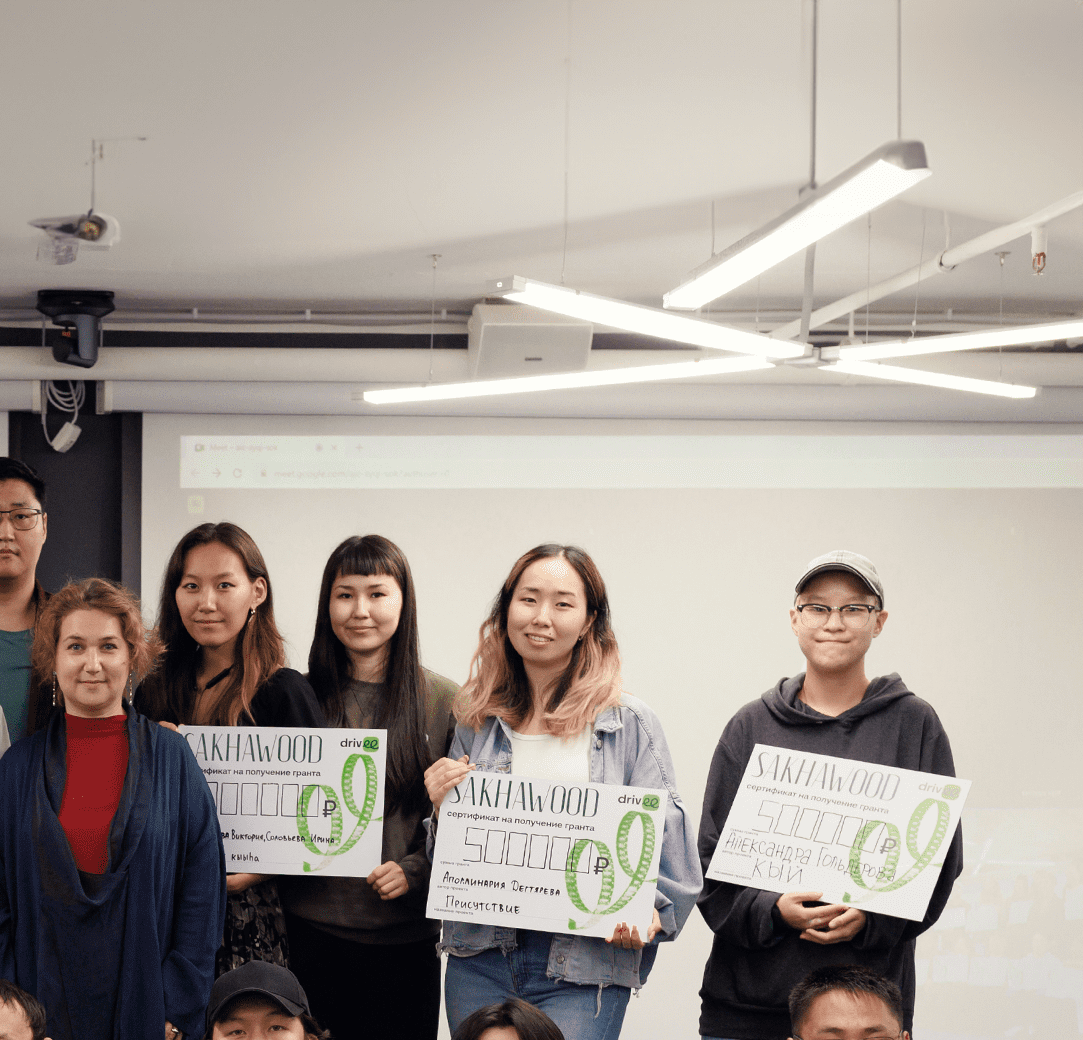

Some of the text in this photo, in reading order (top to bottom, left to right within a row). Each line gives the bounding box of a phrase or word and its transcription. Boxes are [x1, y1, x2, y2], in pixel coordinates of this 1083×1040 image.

[340, 738, 379, 750] drivee
[245, 769, 291, 777] получение
[293, 769, 321, 777] гранта
[751, 751, 901, 801] SAKHAWOOD
[918, 782, 961, 798] drivee
[618, 794, 660, 809] drivee
[747, 784, 797, 798] сертификат
[810, 794, 858, 809] получение
[859, 803, 890, 814] гранта
[447, 810, 595, 832] сертификат на получение гранта
